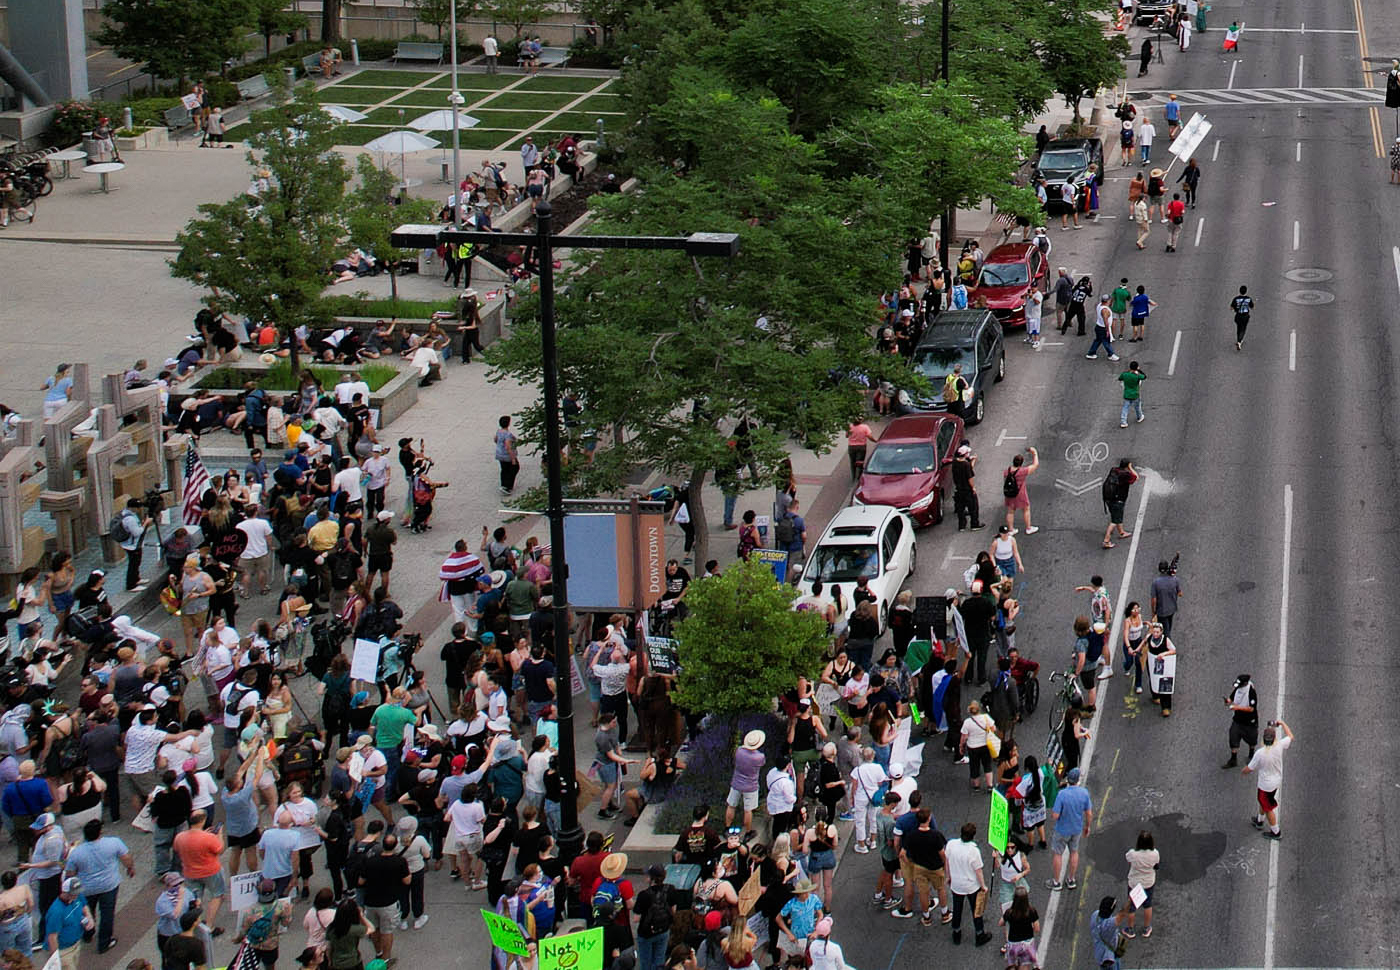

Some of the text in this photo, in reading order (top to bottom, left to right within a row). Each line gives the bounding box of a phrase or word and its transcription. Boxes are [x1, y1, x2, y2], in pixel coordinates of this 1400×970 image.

[649, 526, 660, 593] DOWNTOWN
[544, 937, 596, 959] Not My
